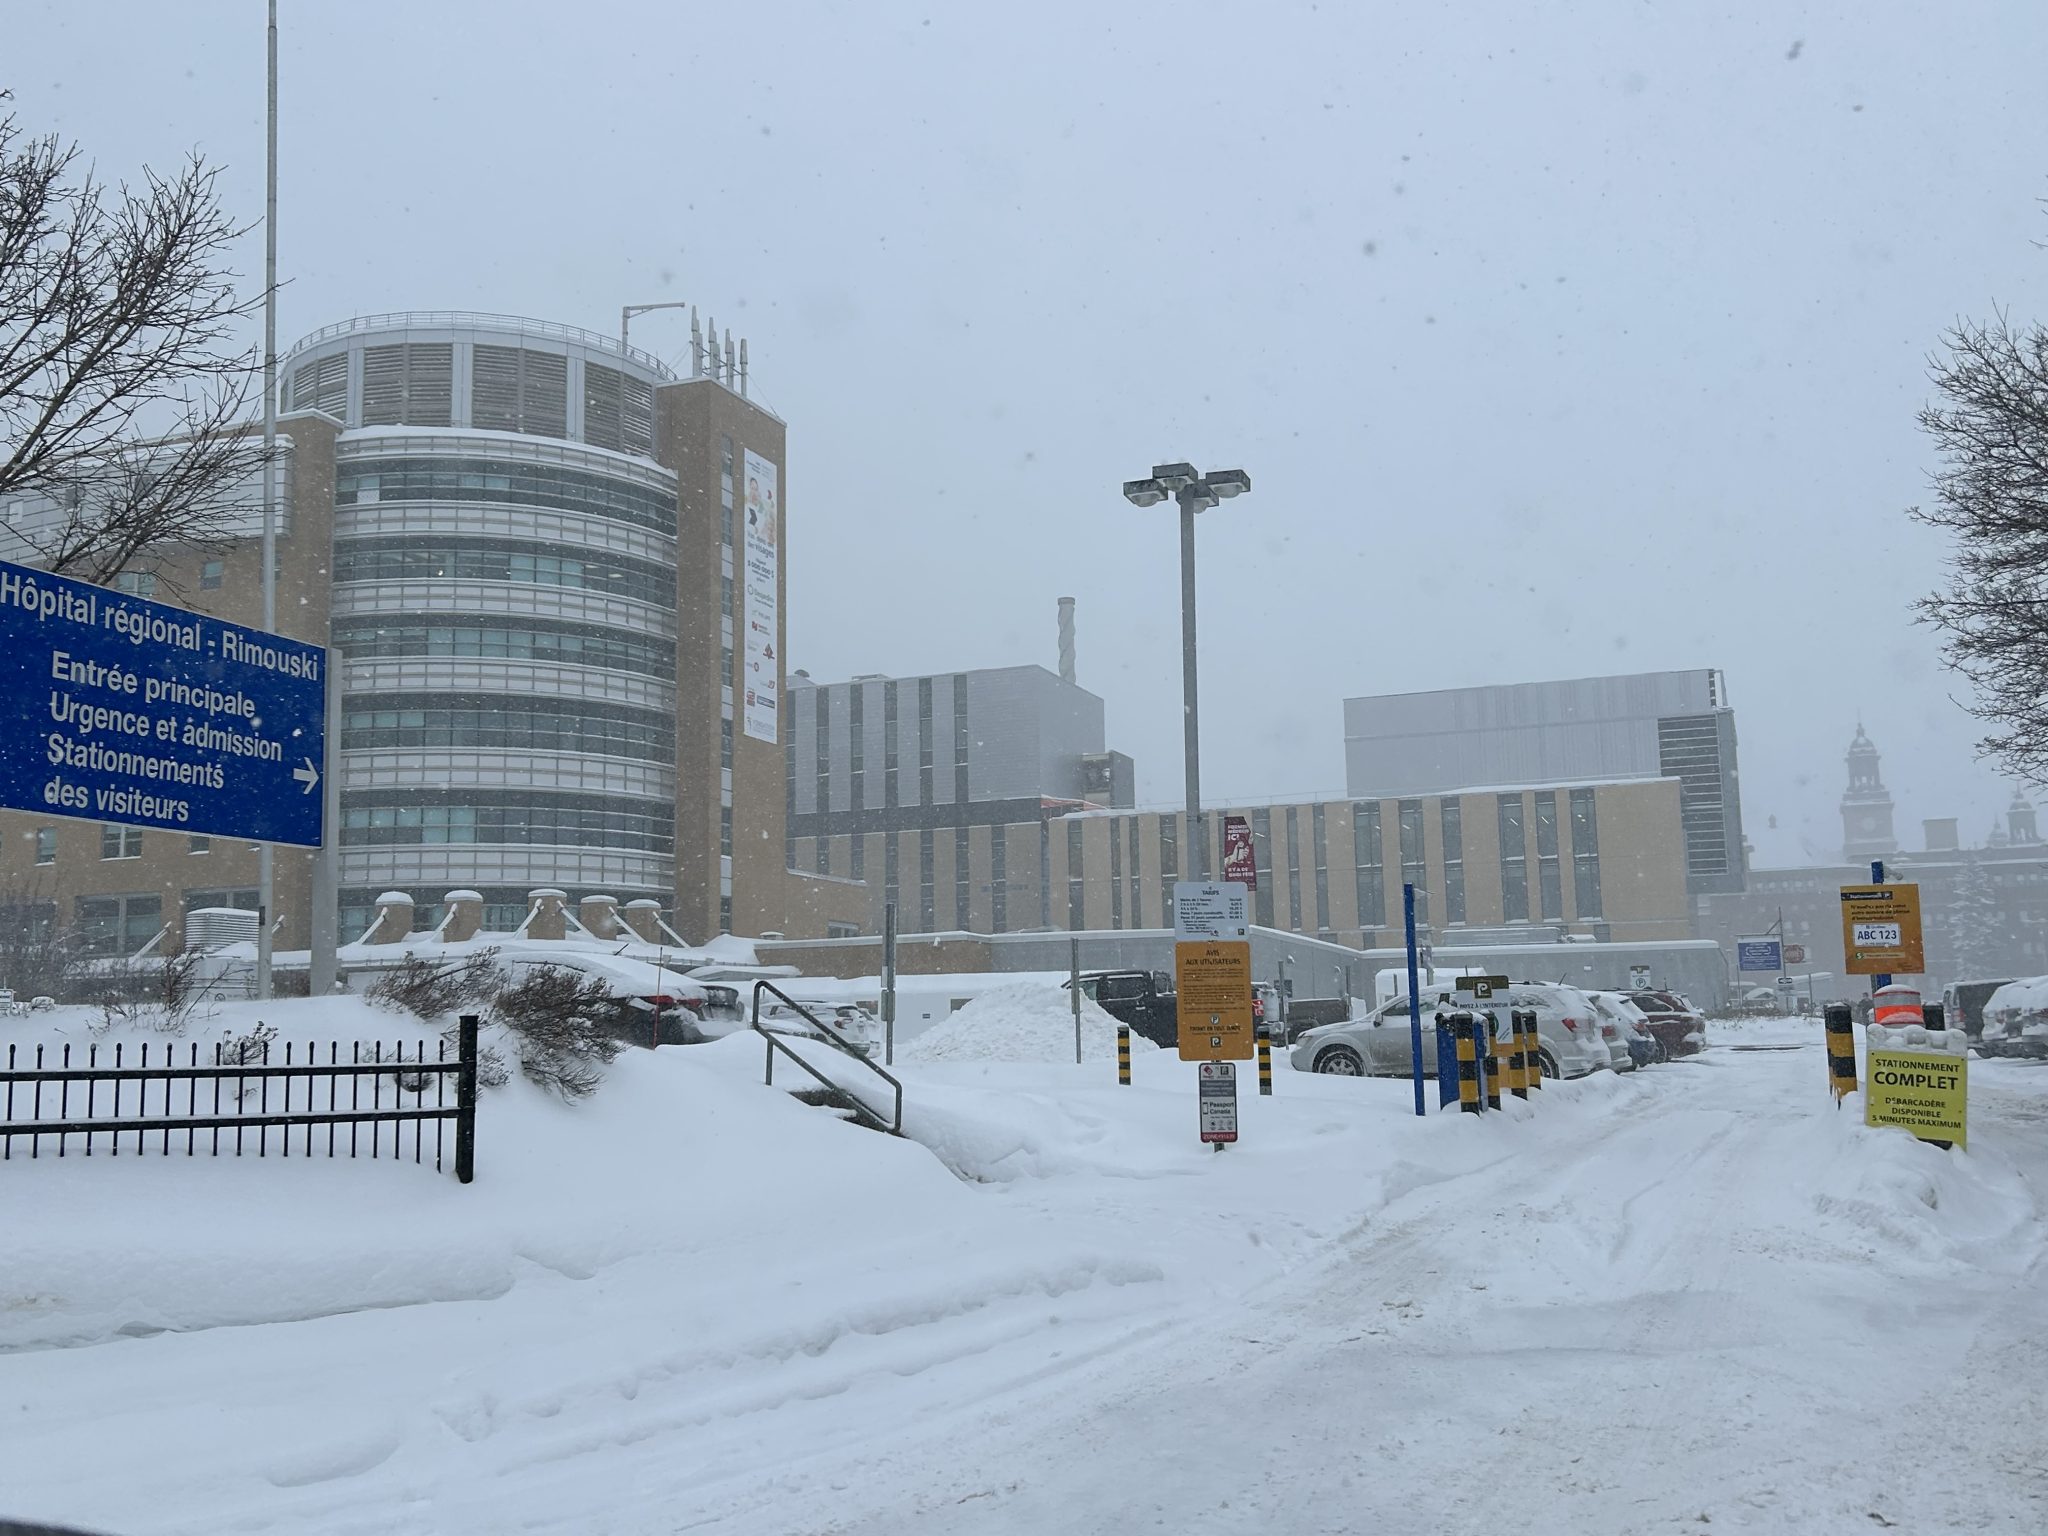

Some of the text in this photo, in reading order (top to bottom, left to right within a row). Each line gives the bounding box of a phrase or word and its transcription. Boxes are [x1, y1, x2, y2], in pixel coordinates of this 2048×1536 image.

[1, 571, 96, 625] Hôpital
[105, 602, 200, 651] régional
[223, 630, 318, 681] Rimouski
[52, 650, 255, 718] Entrée principale
[50, 691, 282, 762] Urgence et admission
[48, 733, 225, 789] Stationnements
[44, 775, 190, 822] des visiteurs
[1858, 930, 1897, 940] ABC 123
[1206, 949, 1220, 957] AVIS
[1876, 1058, 1960, 1072] STATIONNEMENT
[1874, 1072, 1959, 1090] COMPLET
[1879, 1115, 1916, 1125] MINUTES
[1917, 1118, 1962, 1128] MAXIMUM
[1892, 1107, 1941, 1118] DISPONIBLE
